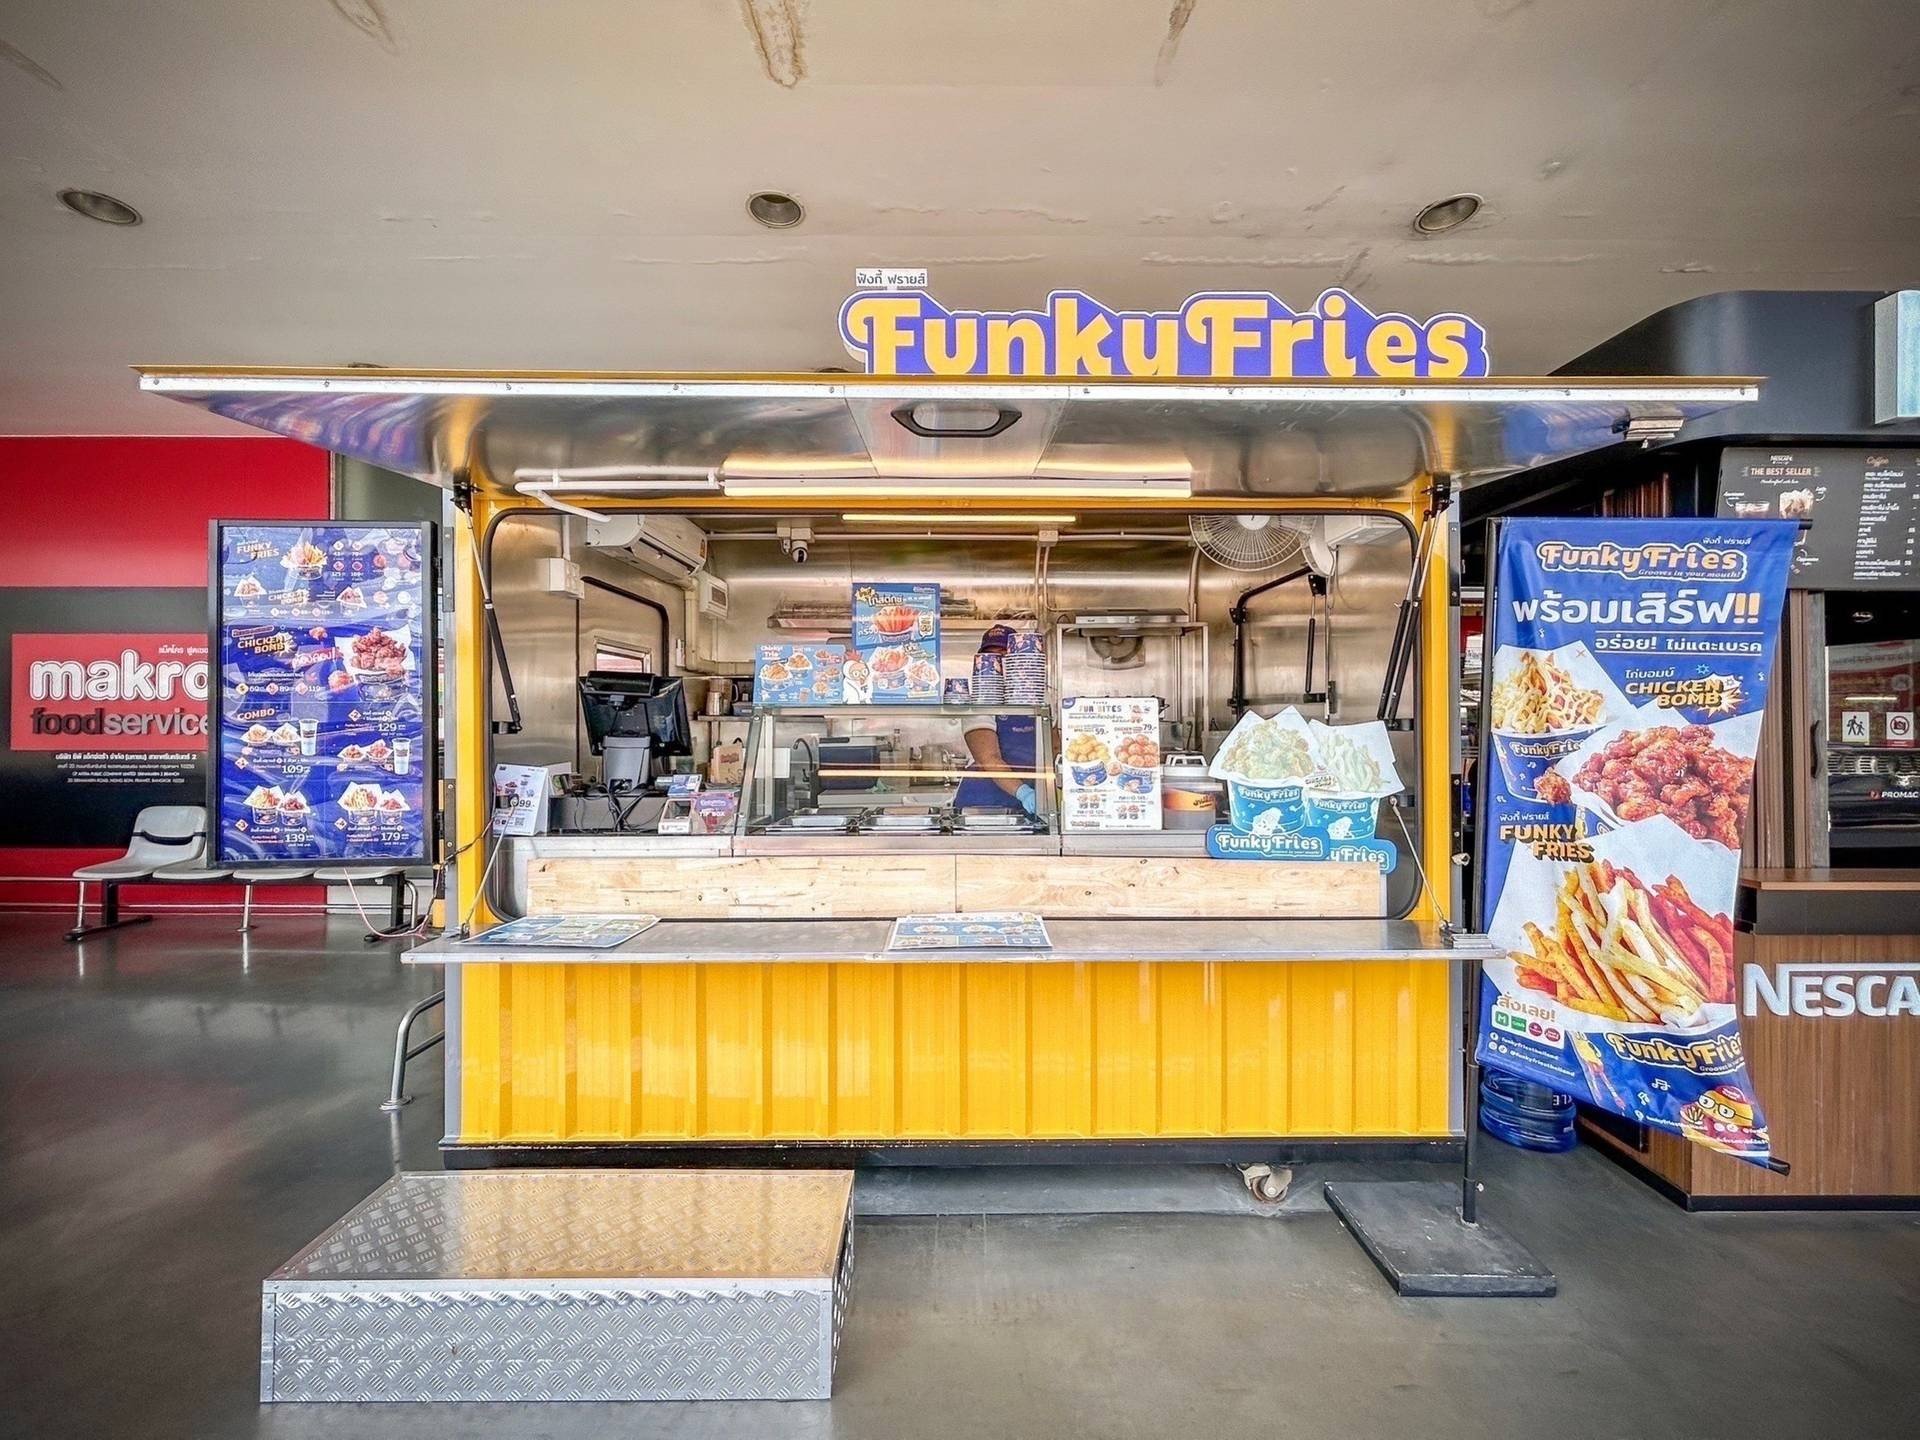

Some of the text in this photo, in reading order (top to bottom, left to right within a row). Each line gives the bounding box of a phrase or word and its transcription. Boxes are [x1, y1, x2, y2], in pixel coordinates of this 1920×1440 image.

[857, 269, 925, 284] ฟังกี้ ฟรายส์
[1751, 467, 1812, 475] THE BEST SELLER
[237, 542, 272, 554] FUNKY
[1542, 545, 1738, 572] FunkyFries
[1512, 589, 1761, 625] พร้อมเสิร์ฟ!!
[238, 635, 285, 649] CHICKEN
[254, 643, 285, 654] BOMB
[1595, 633, 1762, 652] อร่อย! ไม่แตะเบรค
[30, 649, 208, 701] makro
[1625, 666, 1676, 679] ไก่บอมบ์
[1625, 679, 1723, 695] CHICKEN
[1657, 692, 1722, 708] BOMB
[31, 706, 208, 736] foodservice
[236, 708, 275, 720] COMBO
[378, 723, 397, 732] 129
[1512, 741, 1583, 758] FunkyFrie
[282, 765, 304, 774] 109
[1881, 790, 1919, 798] PROMAC
[285, 833, 305, 843] 139
[381, 832, 401, 841] 179
[1500, 824, 1576, 842] FUNKY
[1220, 836, 1319, 853] FunkyFries
[1532, 841, 1594, 862] FRIES
[1327, 850, 1386, 862] yFries
[1498, 991, 1556, 1022] สั่งเลย!
[1607, 1032, 1741, 1069] FunkyFrie
